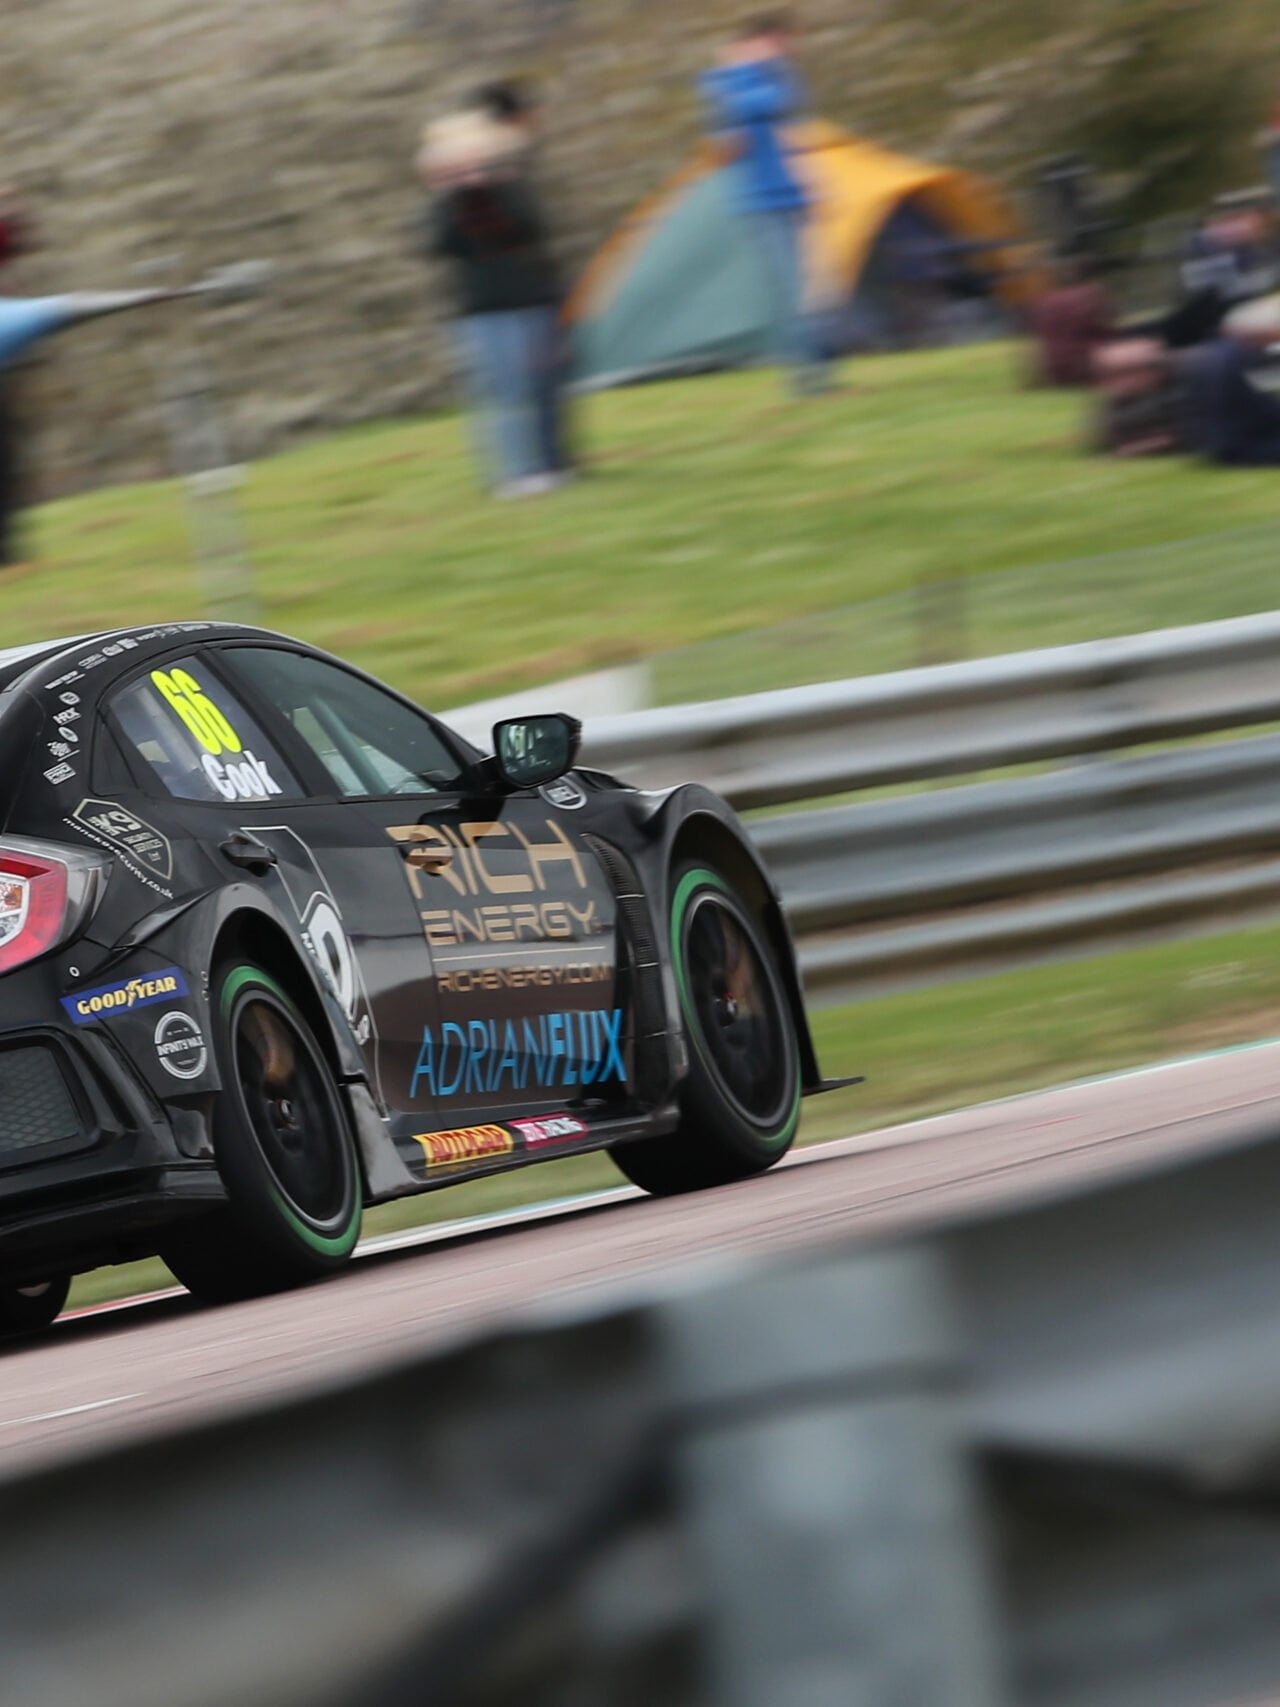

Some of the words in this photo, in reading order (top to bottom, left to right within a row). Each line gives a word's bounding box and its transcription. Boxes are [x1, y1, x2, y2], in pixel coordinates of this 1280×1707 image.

[150, 668, 242, 755] 66
[201, 750, 283, 800] Cook
[385, 819, 587, 899] RICH
[421, 901, 595, 946] ENERGY
[436, 962, 612, 993] RICHENERGY.COM
